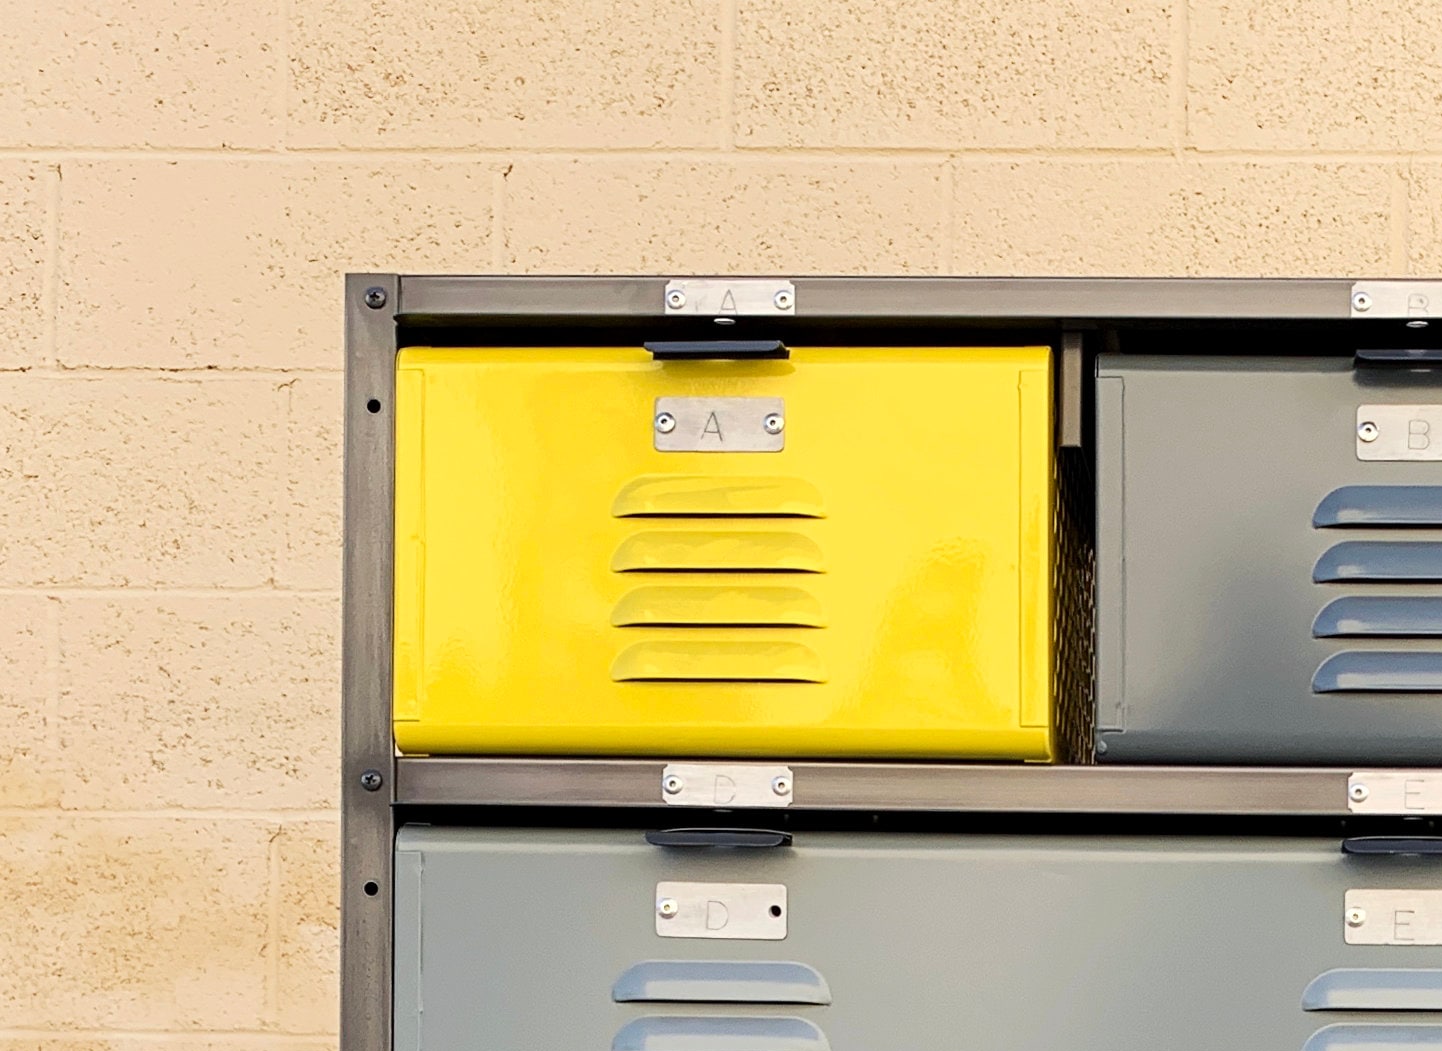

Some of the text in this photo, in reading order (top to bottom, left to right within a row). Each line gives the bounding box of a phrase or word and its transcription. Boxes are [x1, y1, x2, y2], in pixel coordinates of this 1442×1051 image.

[719, 289, 738, 315] A
[701, 411, 724, 442] A
[1407, 419, 1431, 451] B
[713, 774, 737, 805] D
[1404, 779, 1426, 810] E
[705, 900, 730, 931] D
[1394, 910, 1416, 941] E
